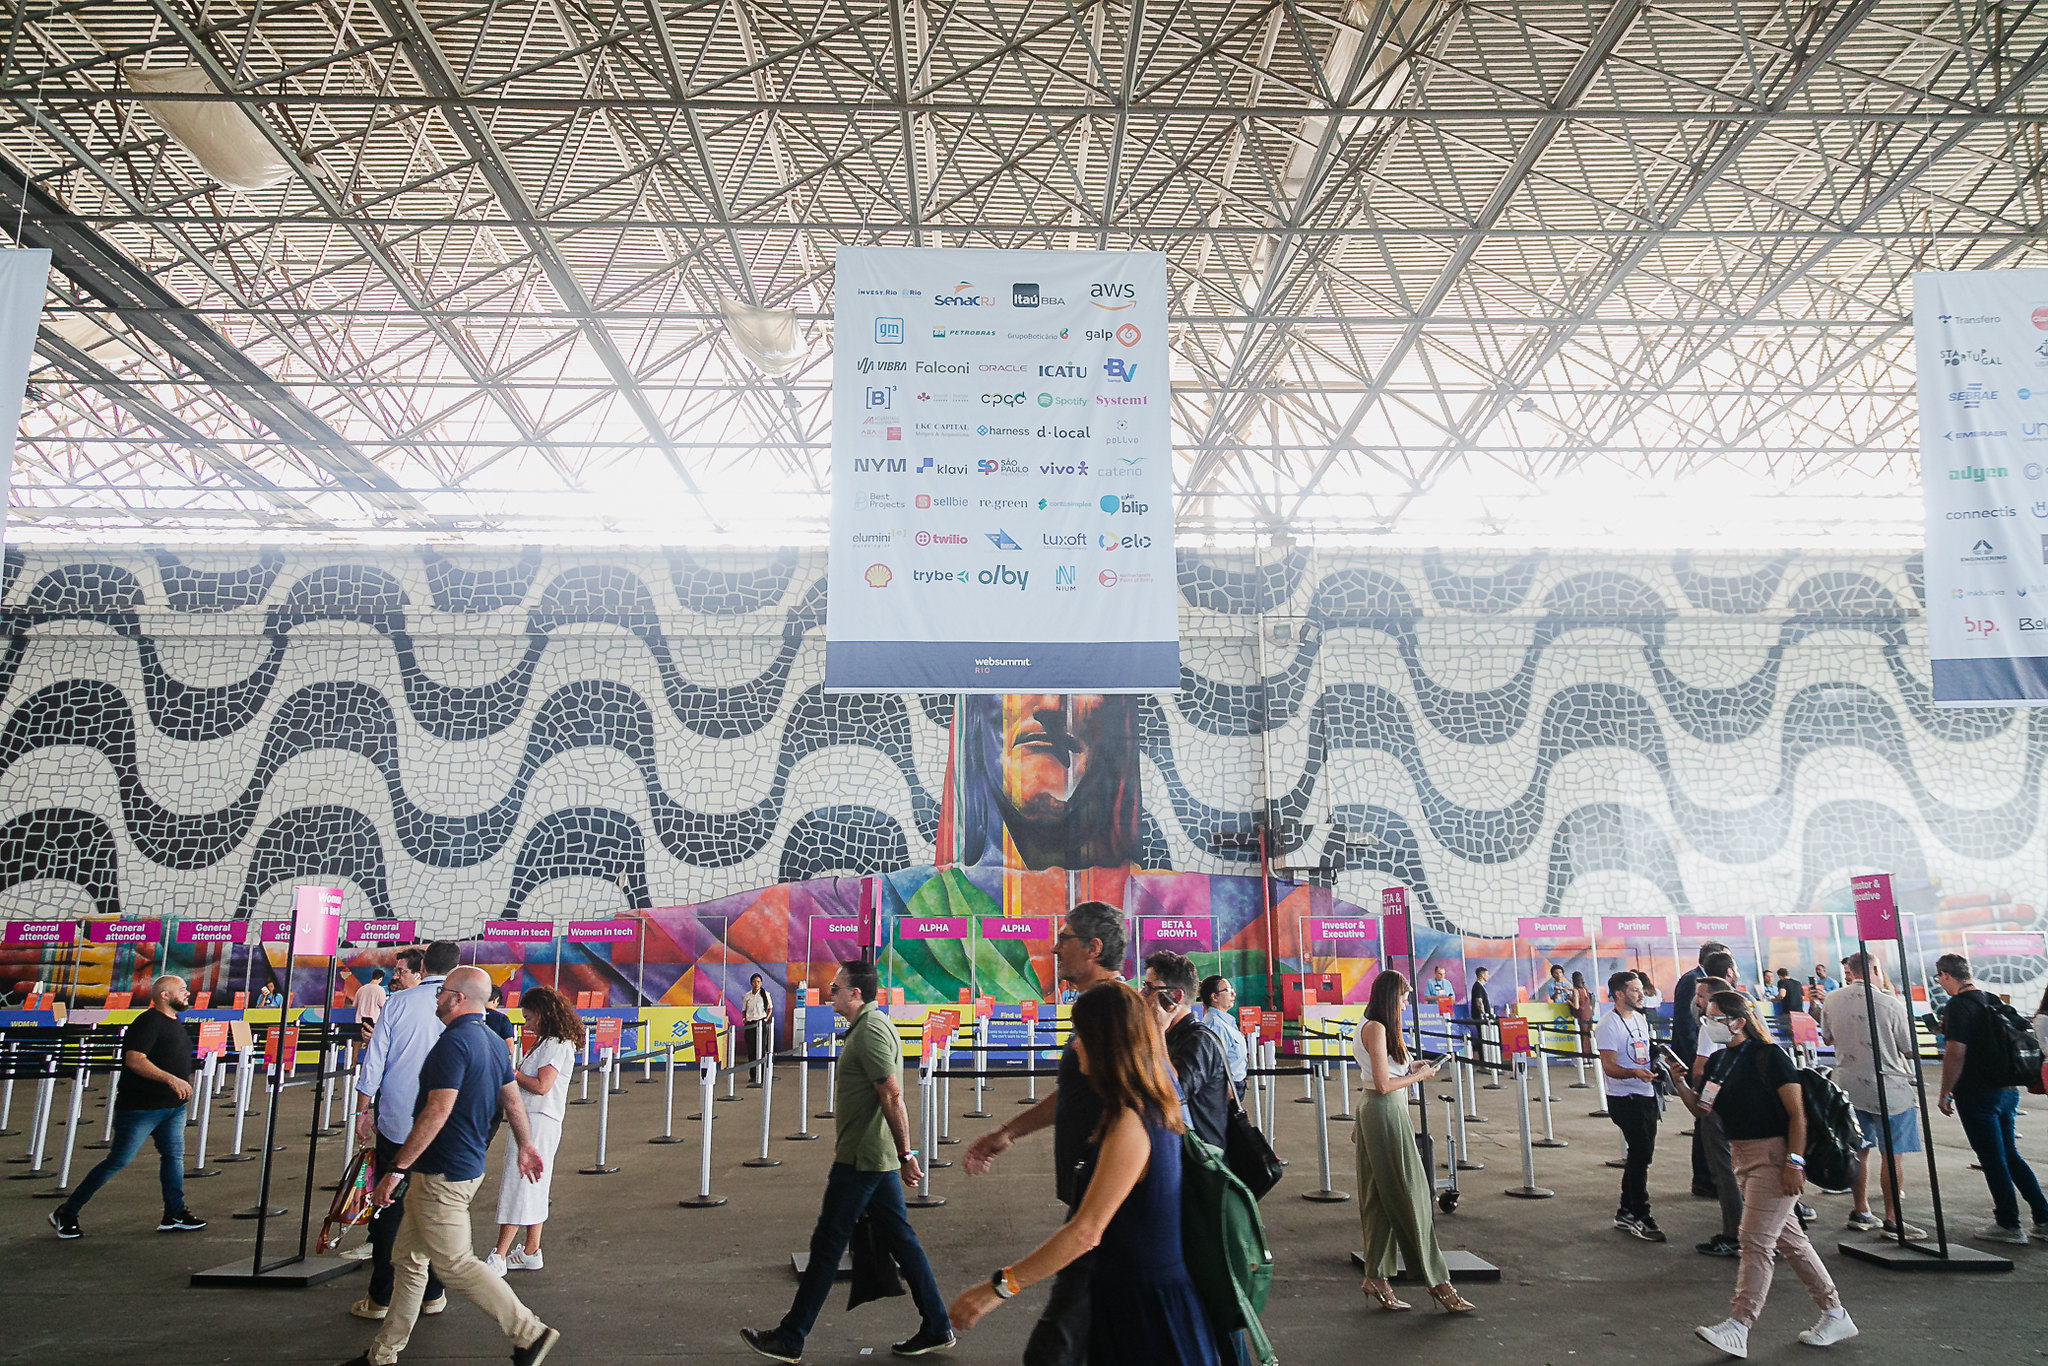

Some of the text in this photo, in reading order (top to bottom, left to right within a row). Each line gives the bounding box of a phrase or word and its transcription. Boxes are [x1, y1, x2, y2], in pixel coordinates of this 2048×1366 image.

[1090, 283, 1135, 298] aws
[1041, 297, 1066, 305] BBA
[1954, 315, 2001, 324] Transfero
[880, 323, 899, 337] gm
[1085, 329, 1113, 341] galp
[915, 361, 970, 374] Falconi
[1039, 365, 1087, 378] ICATU
[1948, 391, 1999, 401] SEBRAE
[1055, 396, 1088, 407] Spotify
[934, 423, 969, 431] CAPITAL
[989, 426, 1030, 436] harness
[854, 458, 907, 472] NYM
[1000, 458, 1018, 467] SÃO
[937, 464, 968, 475] klavi
[1039, 462, 1075, 475] vivo
[1948, 466, 2009, 482] adyen
[869, 492, 890, 500] Best
[869, 501, 906, 509] Projects
[933, 497, 969, 507] sellbie
[1121, 501, 1149, 515] blip
[1945, 506, 2017, 520] connectis
[852, 533, 891, 543] elumini
[932, 534, 968, 545] twilio
[913, 570, 954, 583] trybe
[23, 923, 59, 932] General
[109, 923, 145, 932] General
[195, 923, 231, 932] General
[364, 922, 399, 931] General
[828, 923, 858, 933] Schola
[918, 923, 949, 932] ALPHA
[1000, 923, 1031, 933] ALPHA
[1161, 920, 1193, 929] BETA &
[1321, 920, 1365, 930] Investor &
[1534, 922, 1568, 932] Partner
[1617, 922, 1651, 931] Partner
[1695, 921, 1729, 931] Partner
[1779, 921, 1813, 931] Partner
[360, 932, 400, 940] attendee
[487, 926, 550, 937] Women in tech
[571, 926, 633, 936] Women in tech
[1156, 929, 1198, 938] GROWTH
[1322, 929, 1365, 938] Executive
[18, 933, 60, 941] attendee
[105, 933, 147, 941] attendee
[191, 932, 233, 941] attendee
